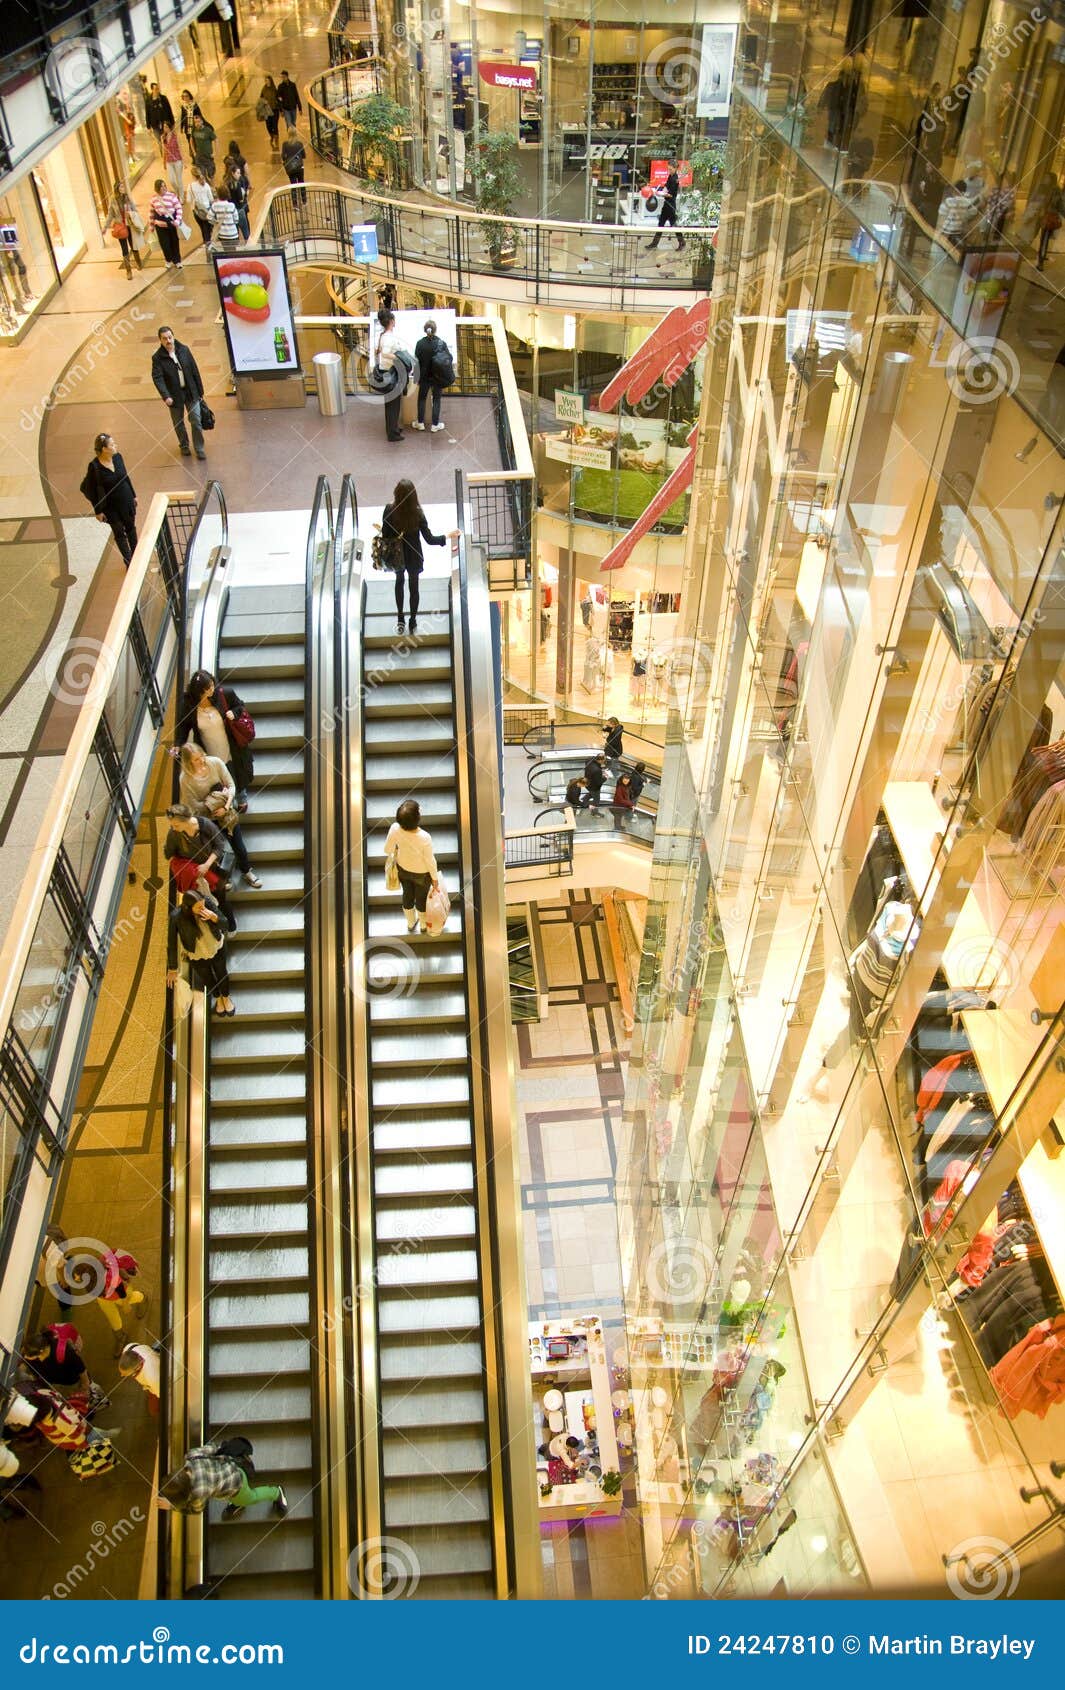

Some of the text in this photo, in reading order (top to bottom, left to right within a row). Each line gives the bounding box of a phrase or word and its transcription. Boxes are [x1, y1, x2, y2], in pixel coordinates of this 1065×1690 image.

[495, 73, 533, 88] basys.net
[561, 395, 577, 408] Yves
[558, 404, 581, 418] Rocher
